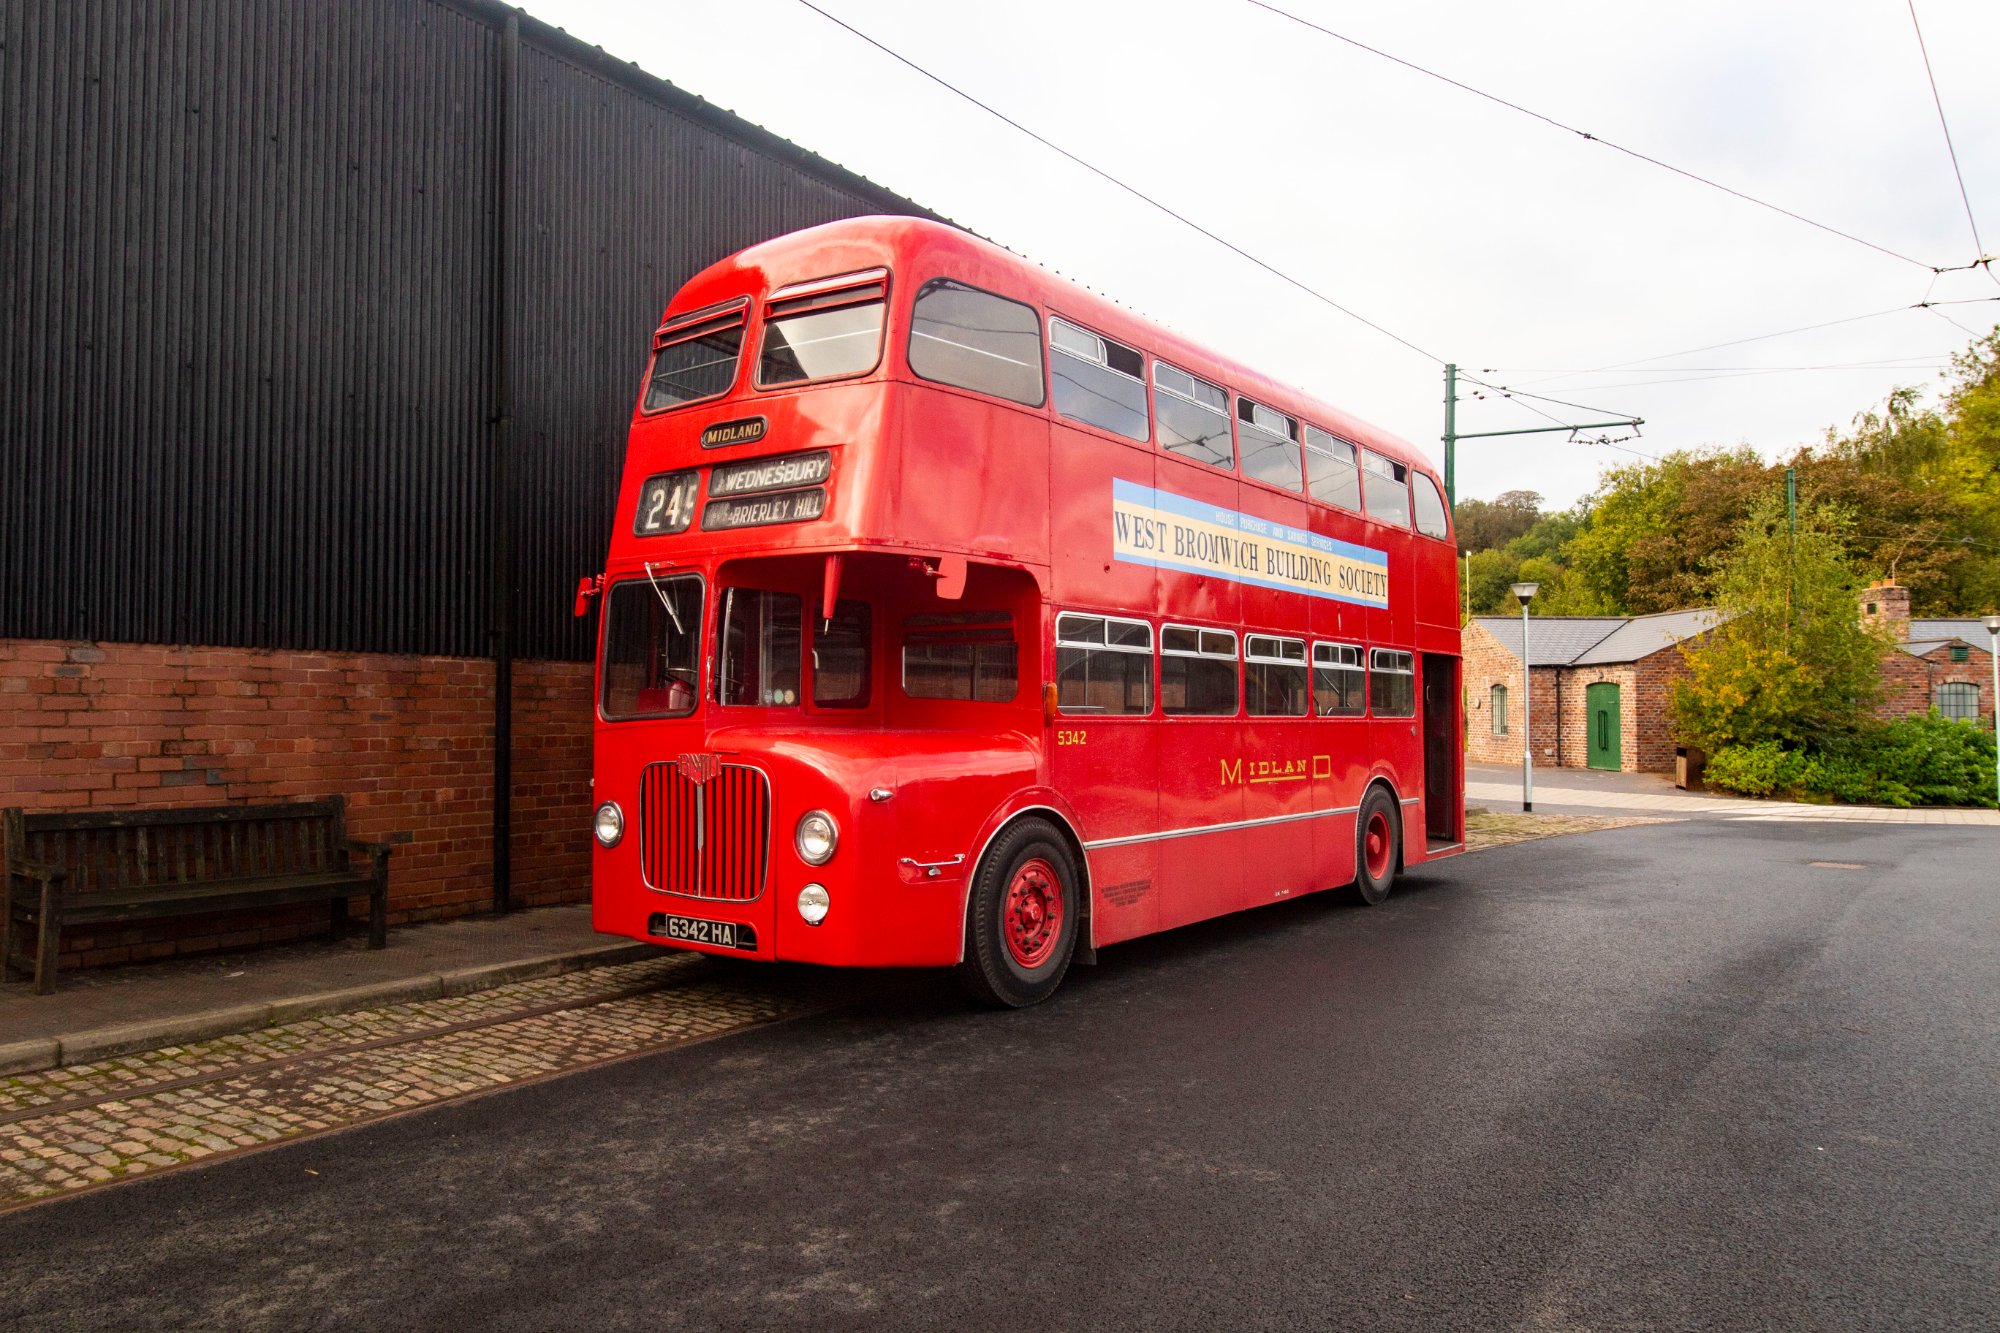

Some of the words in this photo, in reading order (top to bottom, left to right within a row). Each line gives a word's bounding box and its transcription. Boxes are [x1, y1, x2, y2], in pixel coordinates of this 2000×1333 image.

[707, 423, 761, 443] MIDLAND
[725, 460, 828, 491] WEDNESBURY
[731, 500, 790, 525] BRIERLEY
[794, 496, 820, 518] HILL
[1115, 511, 1167, 553] WEST
[1174, 525, 1259, 571] BROMWICH
[1266, 547, 1331, 586] BUILDING
[1339, 564, 1387, 597] SOCIETY
[1058, 730, 1087, 745] 5342
[669, 918, 709, 942] 6342
[711, 923, 733, 945] HA
